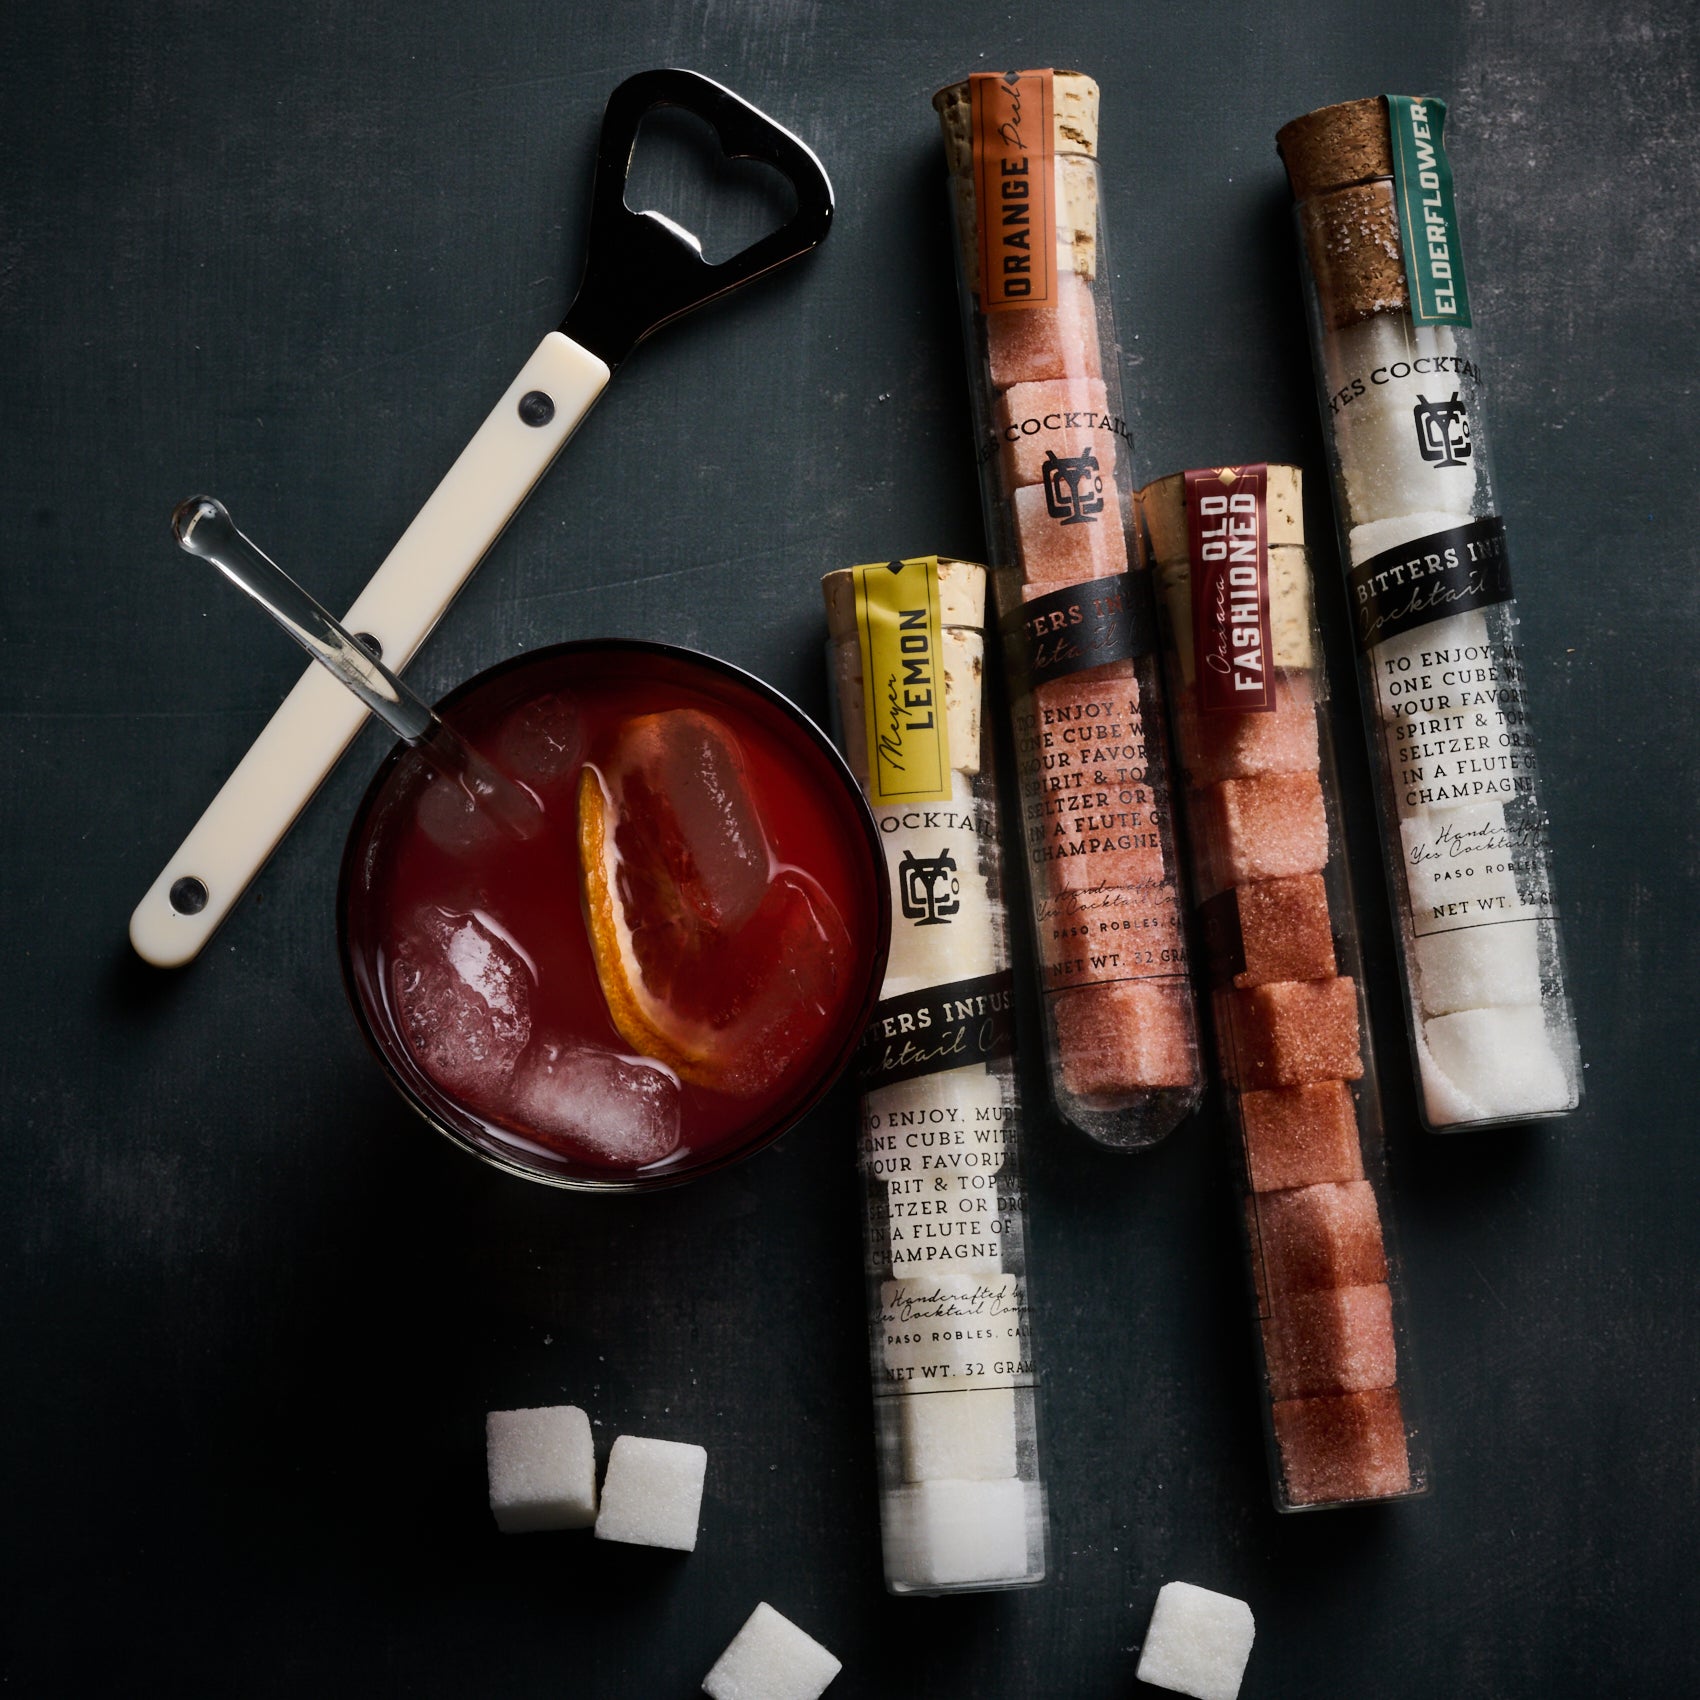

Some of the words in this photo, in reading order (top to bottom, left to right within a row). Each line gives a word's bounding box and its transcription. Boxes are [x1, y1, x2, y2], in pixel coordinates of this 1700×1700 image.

[998, 87, 1028, 150] Peel
[1410, 103, 1457, 315] ELDERFLOWER
[1001, 156, 1031, 298] ORANGE
[1328, 378, 1367, 415] YES
[1200, 494, 1228, 562] OLD
[1356, 547, 1460, 605] BITTERS
[1228, 492, 1265, 691] FASHIONED
[898, 607, 934, 732] LEMON
[1385, 656, 1411, 675] TO
[1389, 675, 1433, 696] ONE
[1442, 667, 1498, 686] CUBE
[1391, 695, 1452, 719] YOUR
[878, 672, 913, 772] Meyer
[1063, 723, 1122, 744] CUBE
[1396, 715, 1465, 741] SPIRIT
[1475, 713, 1488, 727] &
[1400, 735, 1491, 763] SELTZER
[1498, 733, 1521, 747] OR
[1022, 752, 1071, 775] YOUR
[1402, 767, 1424, 785] IN
[1434, 764, 1447, 779] A
[1457, 754, 1518, 774] FLUTE
[1024, 772, 1084, 798] SPIRIT
[1094, 769, 1108, 785] &
[1027, 792, 1110, 820] SELTZER
[1119, 788, 1147, 805] OR
[1054, 820, 1066, 837] A
[1075, 811, 1142, 833] FLUTE
[1409, 843, 1443, 866] Yes
[1434, 867, 1475, 882] PASO
[1432, 901, 1470, 919] NET
[1476, 895, 1512, 911] WT.
[1519, 893, 1537, 907] 32
[1053, 925, 1089, 941] PASO
[1053, 958, 1084, 977] NET
[1134, 950, 1154, 966] 32
[865, 1135, 897, 1153] ONE
[905, 1130, 966, 1148] CUBE
[974, 1128, 1018, 1145] WITH
[866, 1157, 912, 1175] YOUR
[922, 1151, 1018, 1170] FAVORITE
[934, 1176, 949, 1193] &
[957, 1174, 998, 1190] TOP
[869, 1199, 949, 1221] SELTZER
[959, 1197, 989, 1213] OR
[892, 1226, 904, 1242] A
[913, 1221, 982, 1239] FLUTE
[990, 1219, 1013, 1235] OF
[890, 1284, 1008, 1309] Handcrafted
[900, 1300, 984, 1323] Cocktail
[887, 1333, 922, 1345] PASO
[887, 1367, 916, 1382] NET
[920, 1364, 957, 1379] WT.
[965, 1362, 986, 1377] 32
